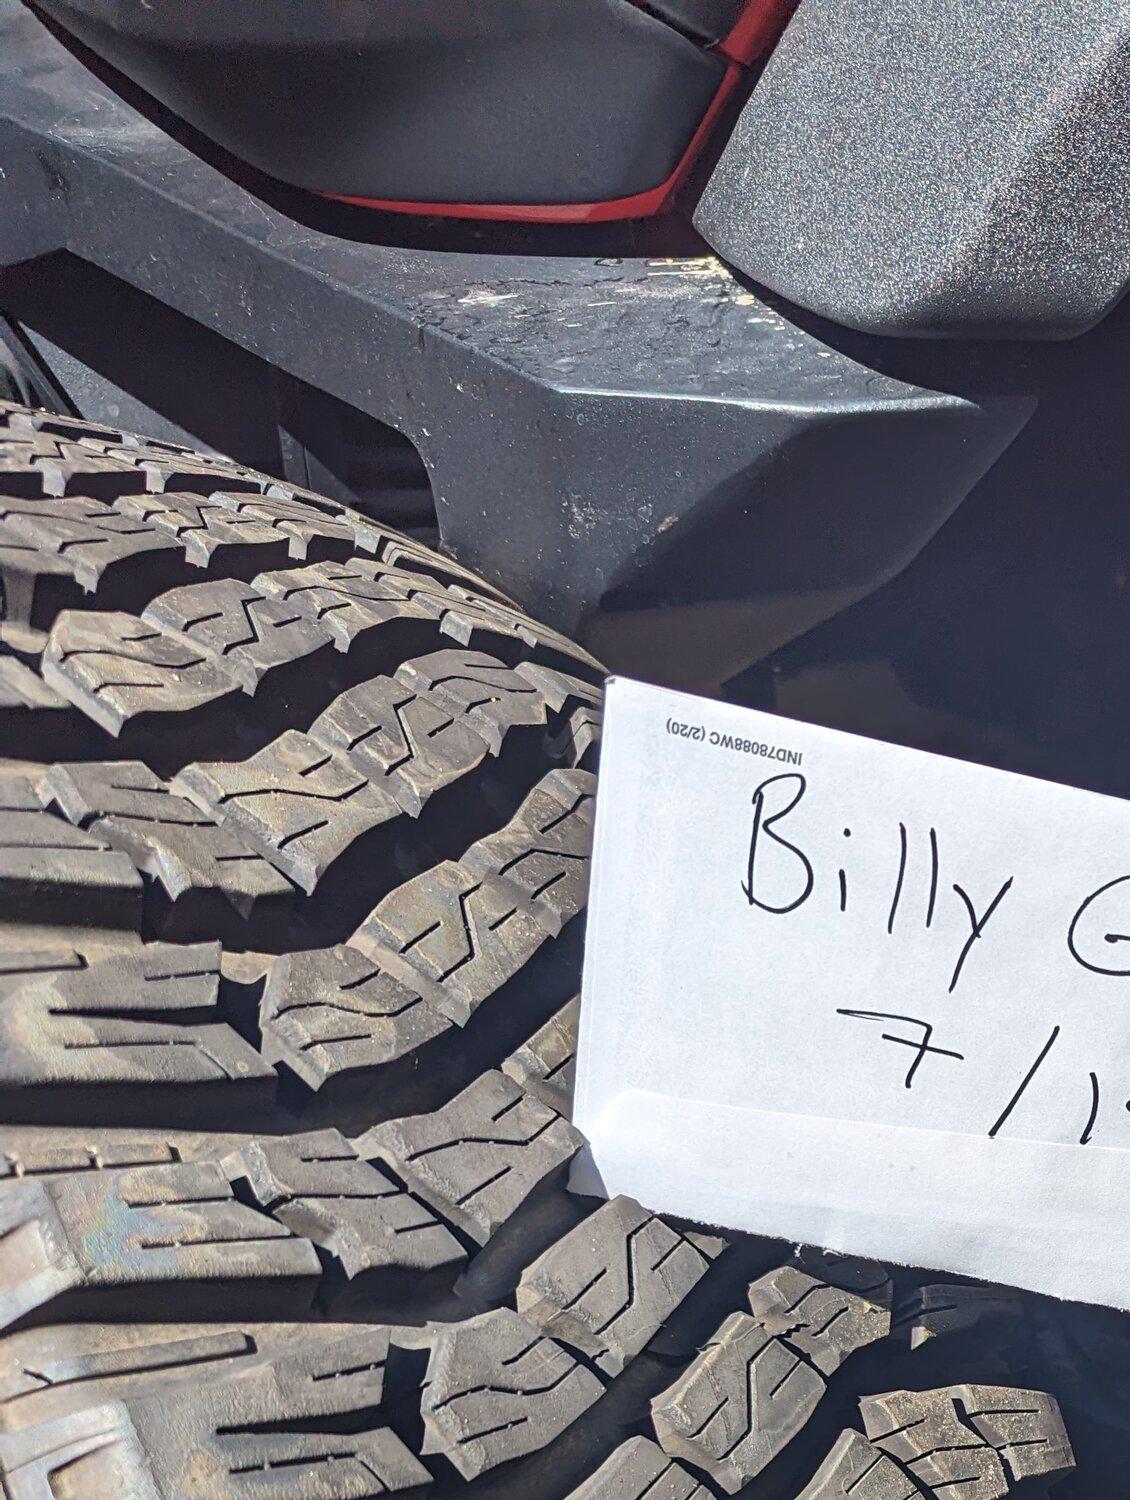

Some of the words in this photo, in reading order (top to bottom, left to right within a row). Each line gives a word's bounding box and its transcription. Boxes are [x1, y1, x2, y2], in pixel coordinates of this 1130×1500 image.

[666, 718, 706, 742] (2/20)
[709, 732, 803, 766] IND78088WC
[740, 773, 1013, 993] Billy
